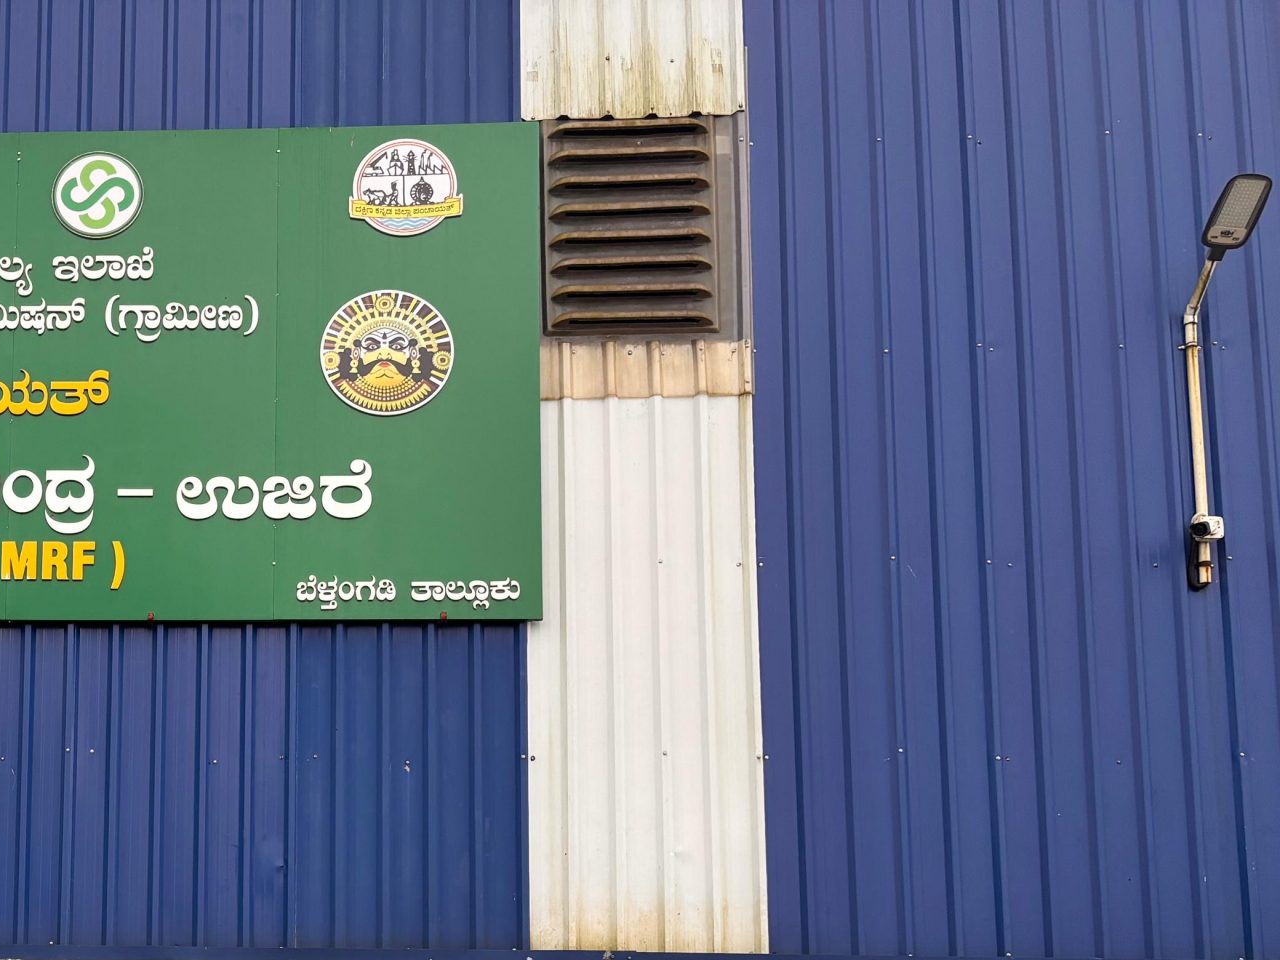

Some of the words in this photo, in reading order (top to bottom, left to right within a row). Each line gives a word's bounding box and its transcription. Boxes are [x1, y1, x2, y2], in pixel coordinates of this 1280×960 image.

[53, 247, 153, 281] ಇಲಾಖೆ
[105, 295, 258, 341] (ಗ್ರಾಮೀಣ)
[176, 459, 372, 519] ಉಜಿರೆ
[297, 575, 396, 609] ಬೆಳ್ತಂಗಡಿ
[411, 577, 520, 608] ತಾಲ್ಲೂಕು
